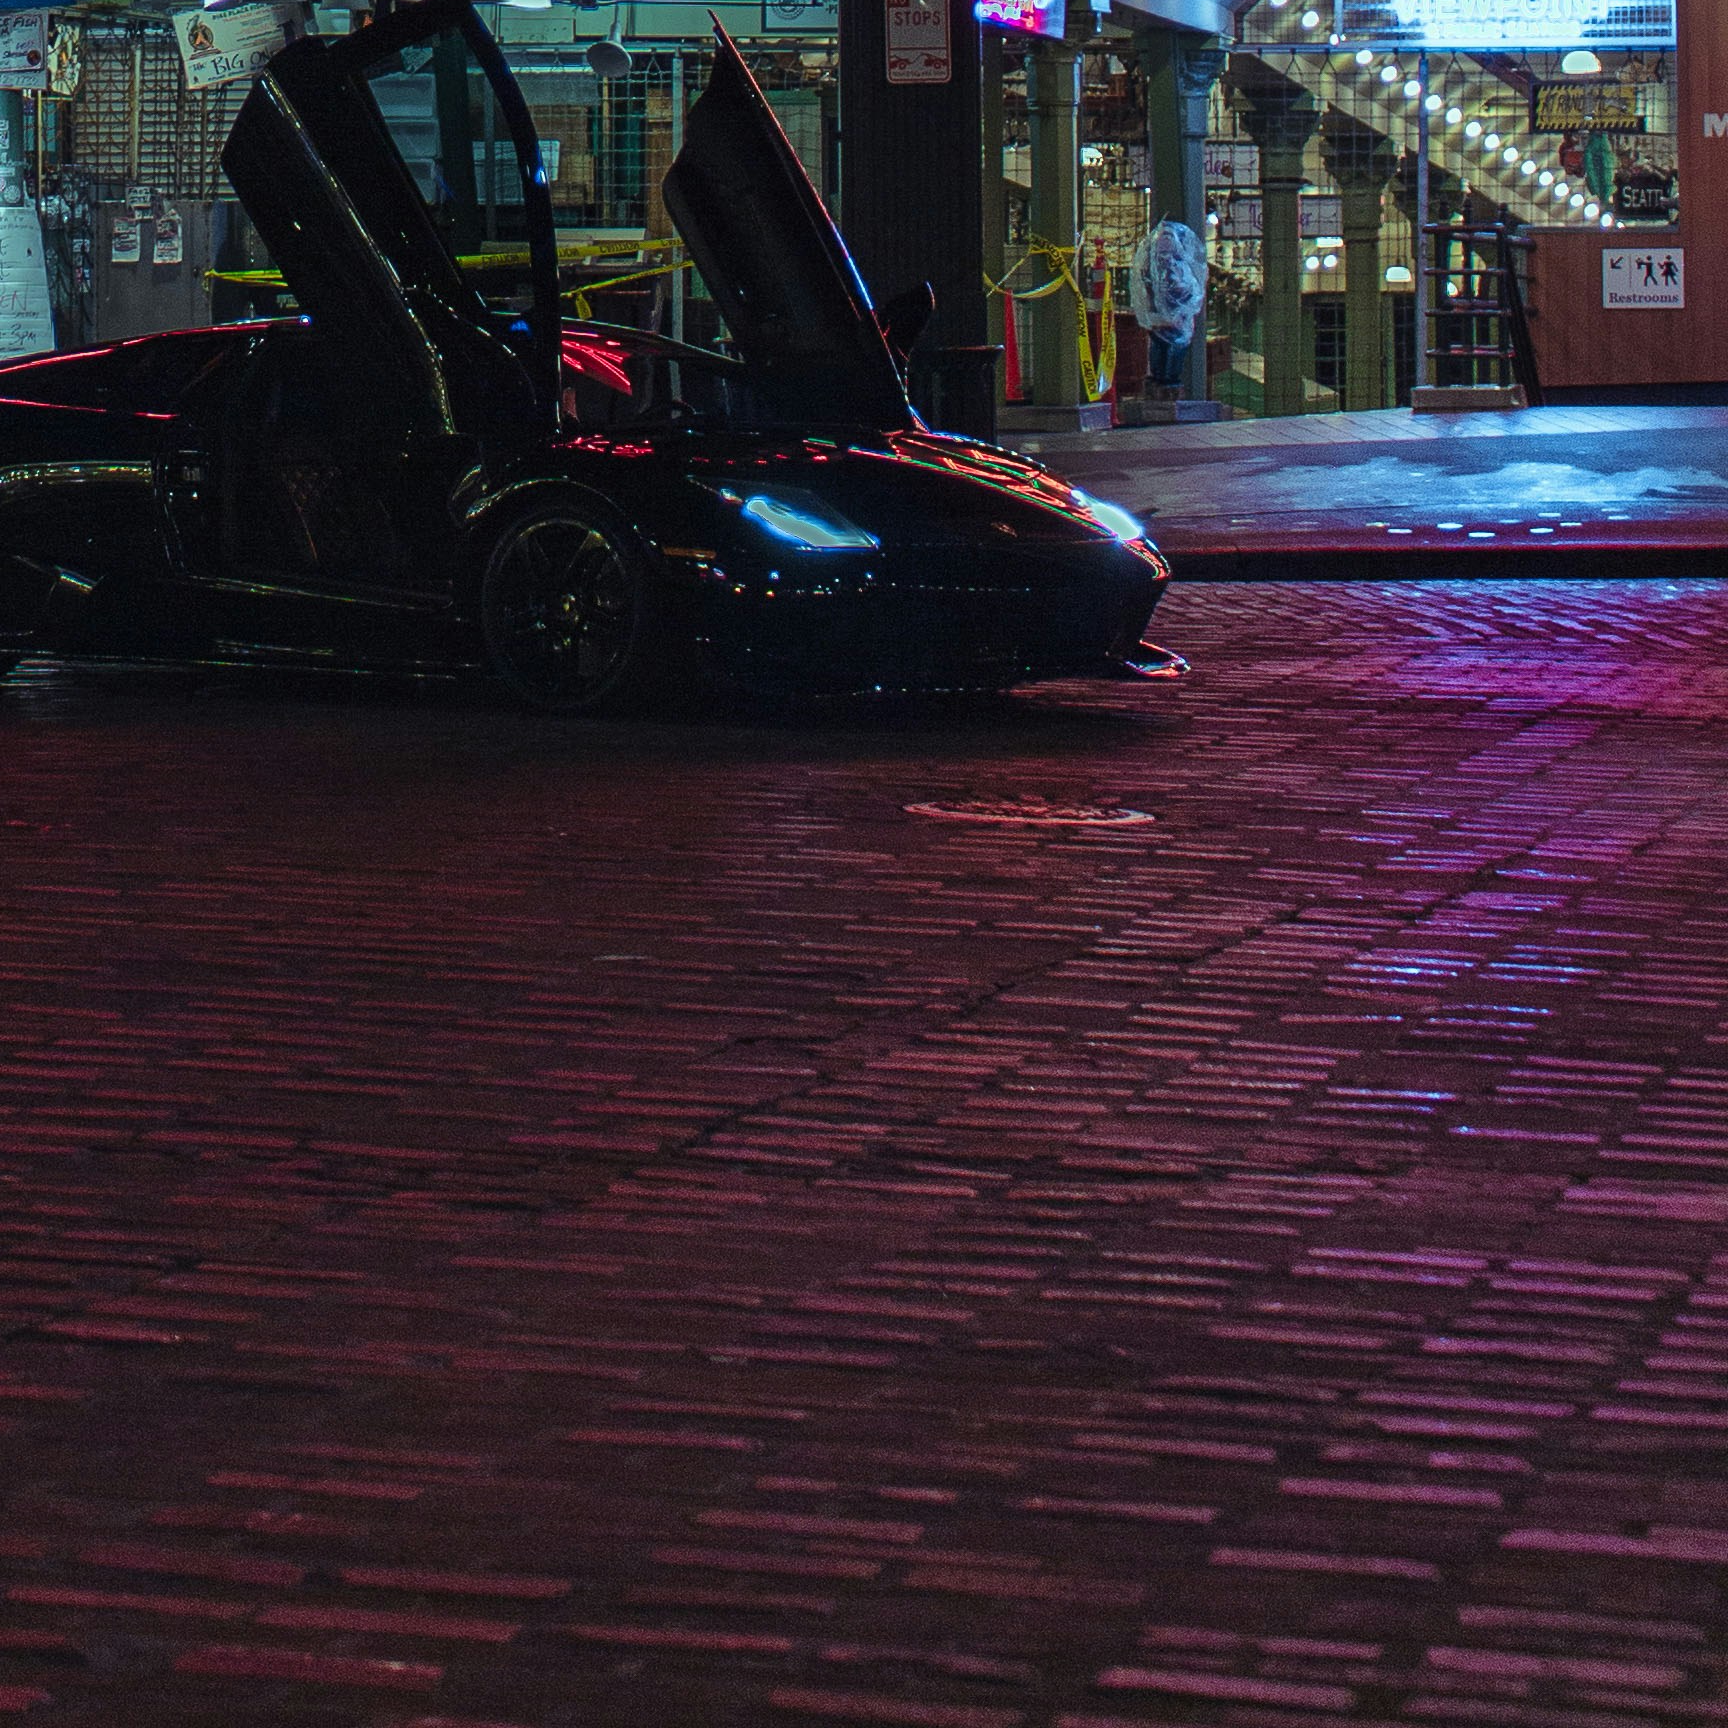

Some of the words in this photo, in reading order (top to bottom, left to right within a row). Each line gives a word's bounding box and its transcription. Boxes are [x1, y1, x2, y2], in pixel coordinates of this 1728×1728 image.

[894, 11, 941, 26] STOPS
[211, 53, 245, 75] BIG
[250, 46, 273, 65] ON
[1608, 291, 1680, 304] Restrooms
